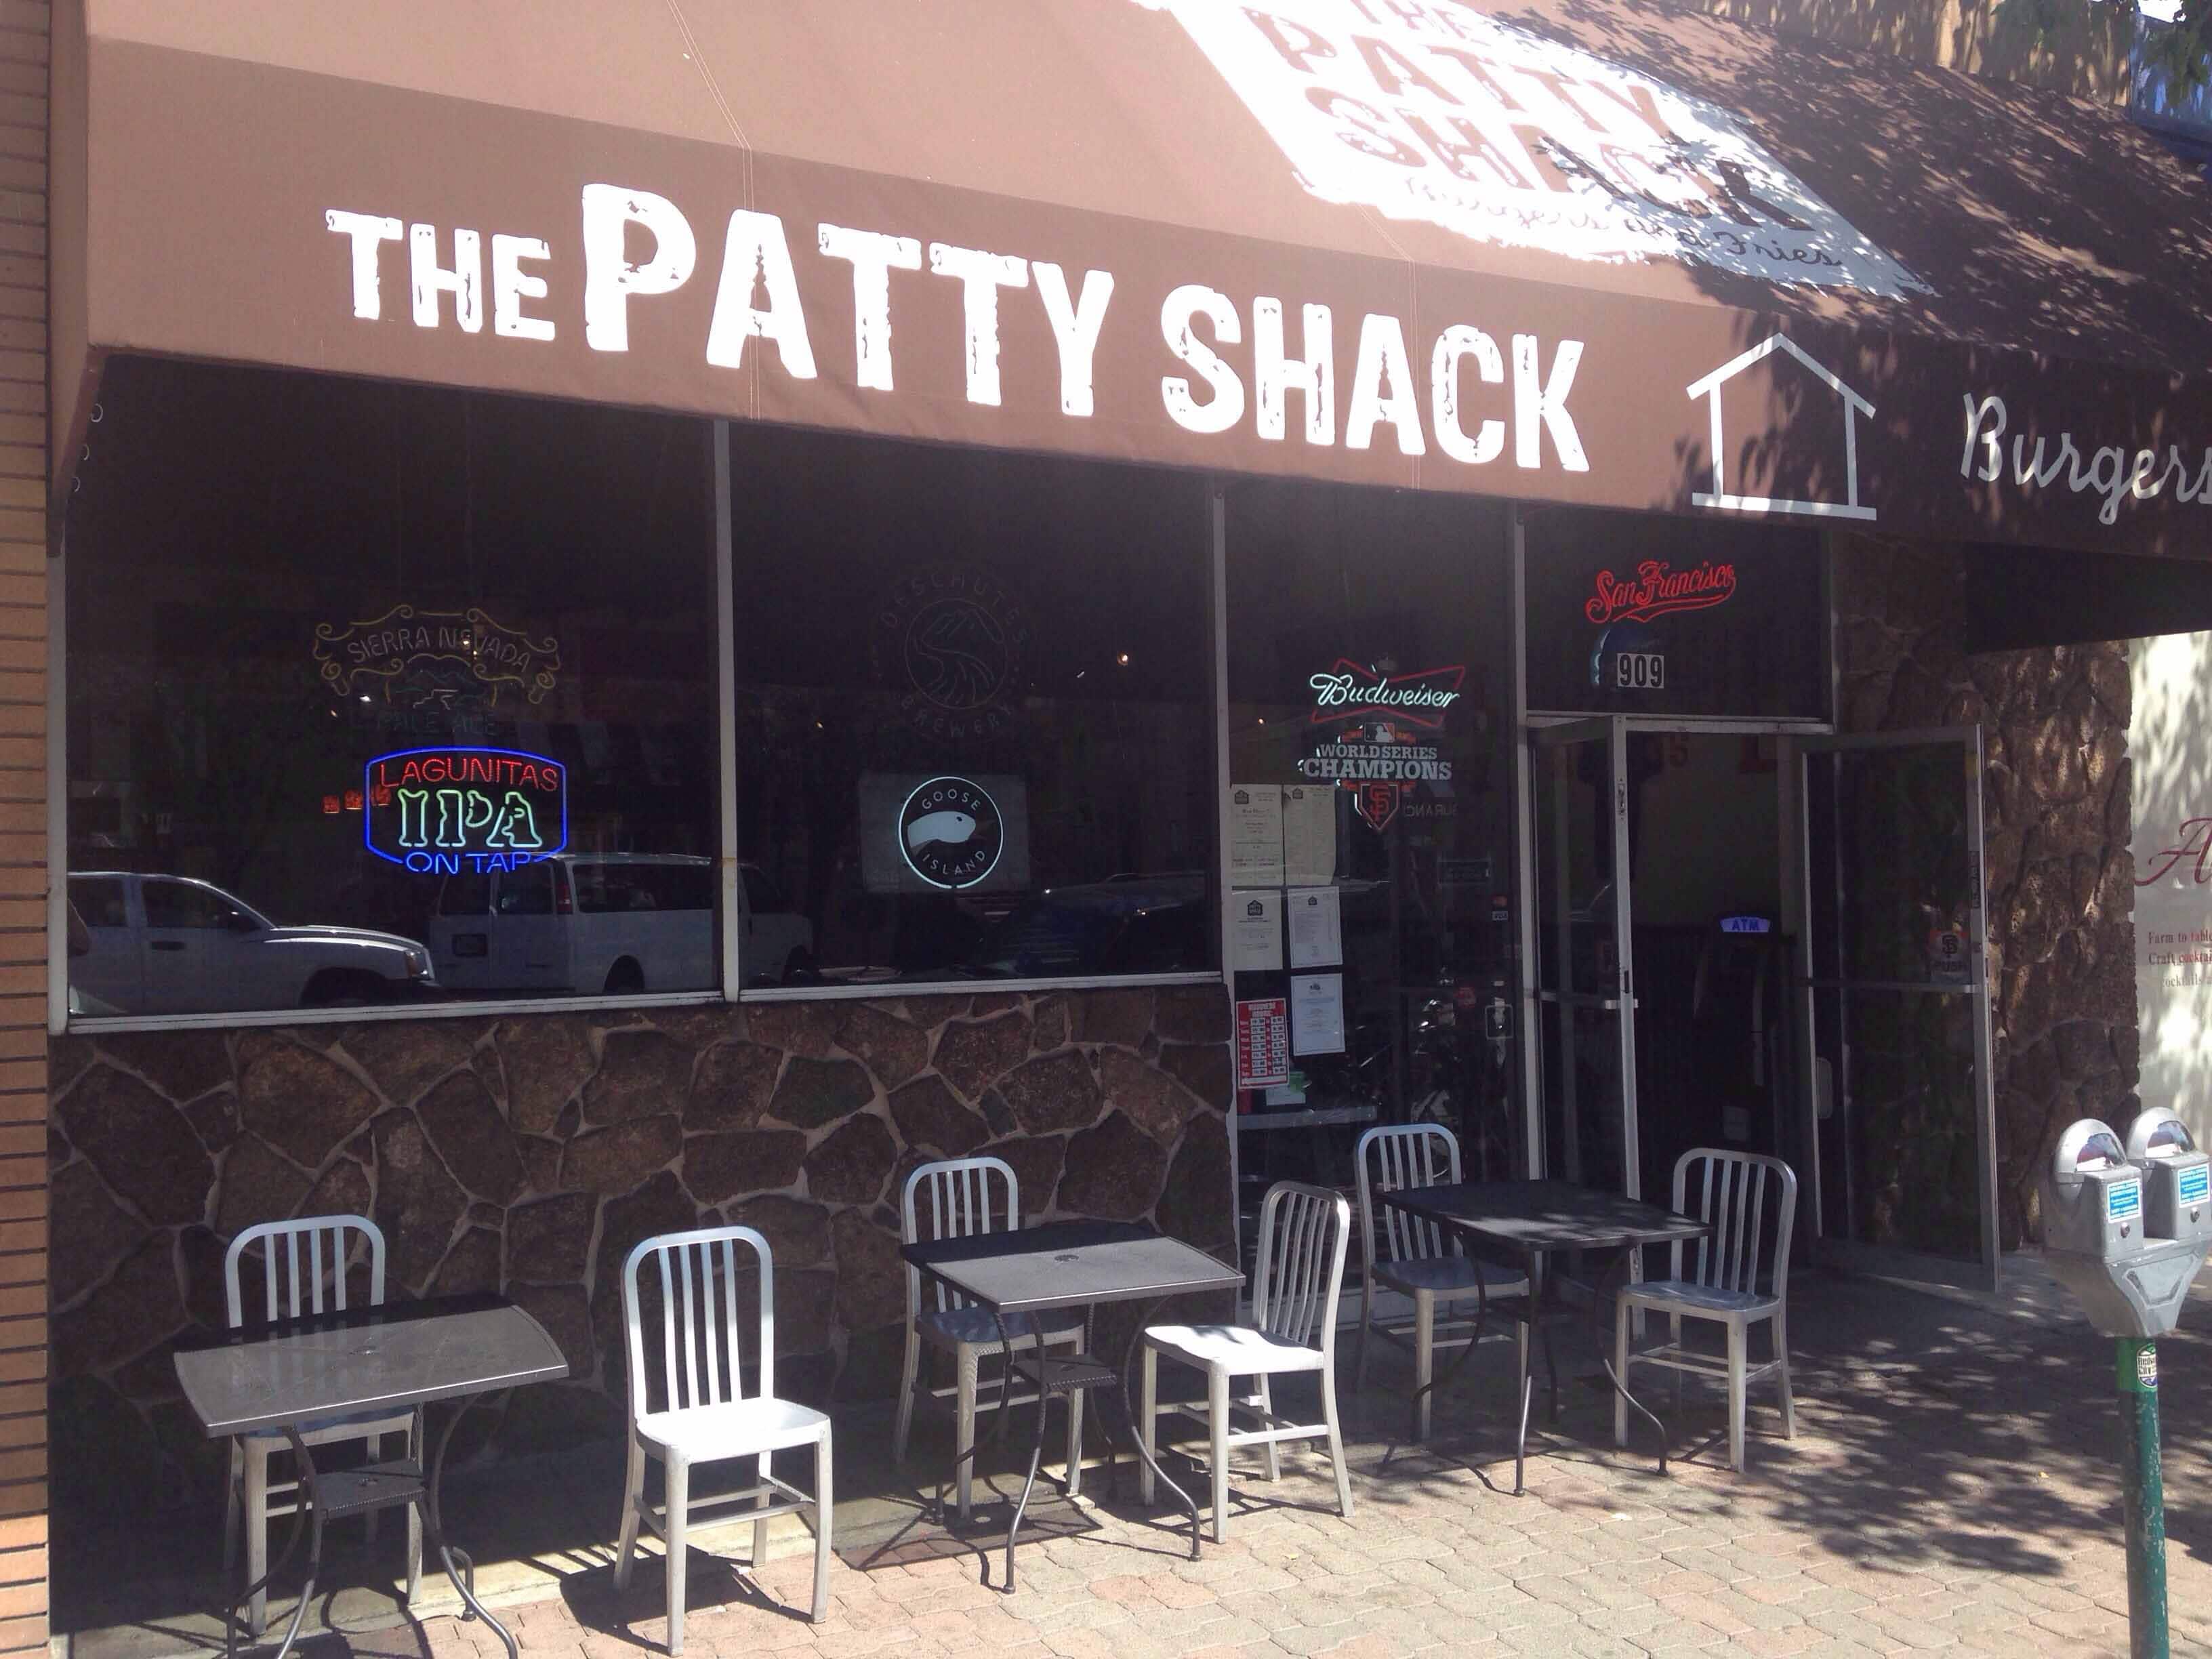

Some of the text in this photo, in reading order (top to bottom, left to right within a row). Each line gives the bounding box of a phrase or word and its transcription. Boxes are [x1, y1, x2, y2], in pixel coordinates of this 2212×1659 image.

[1239, 5, 1692, 147] PATTY
[1713, 231, 1843, 266] Fries
[325, 183, 1591, 473] THE PATTY SHACK
[1585, 569, 1637, 623] San
[347, 627, 431, 663] SIERRA
[1619, 654, 1663, 688] 909
[1309, 673, 1460, 708] Budweiser
[1320, 743, 1438, 760] WORLD SERIES
[380, 758, 559, 792] LAGUNITAS
[1303, 758, 1453, 781] CHAMPIONS
[922, 788, 981, 811] GOOSE
[397, 788, 543, 848] IPA
[407, 851, 533, 874] ON TAP
[922, 850, 986, 876] ISLAND
[1732, 918, 1760, 931] ATM
[2177, 932, 2187, 943] to
